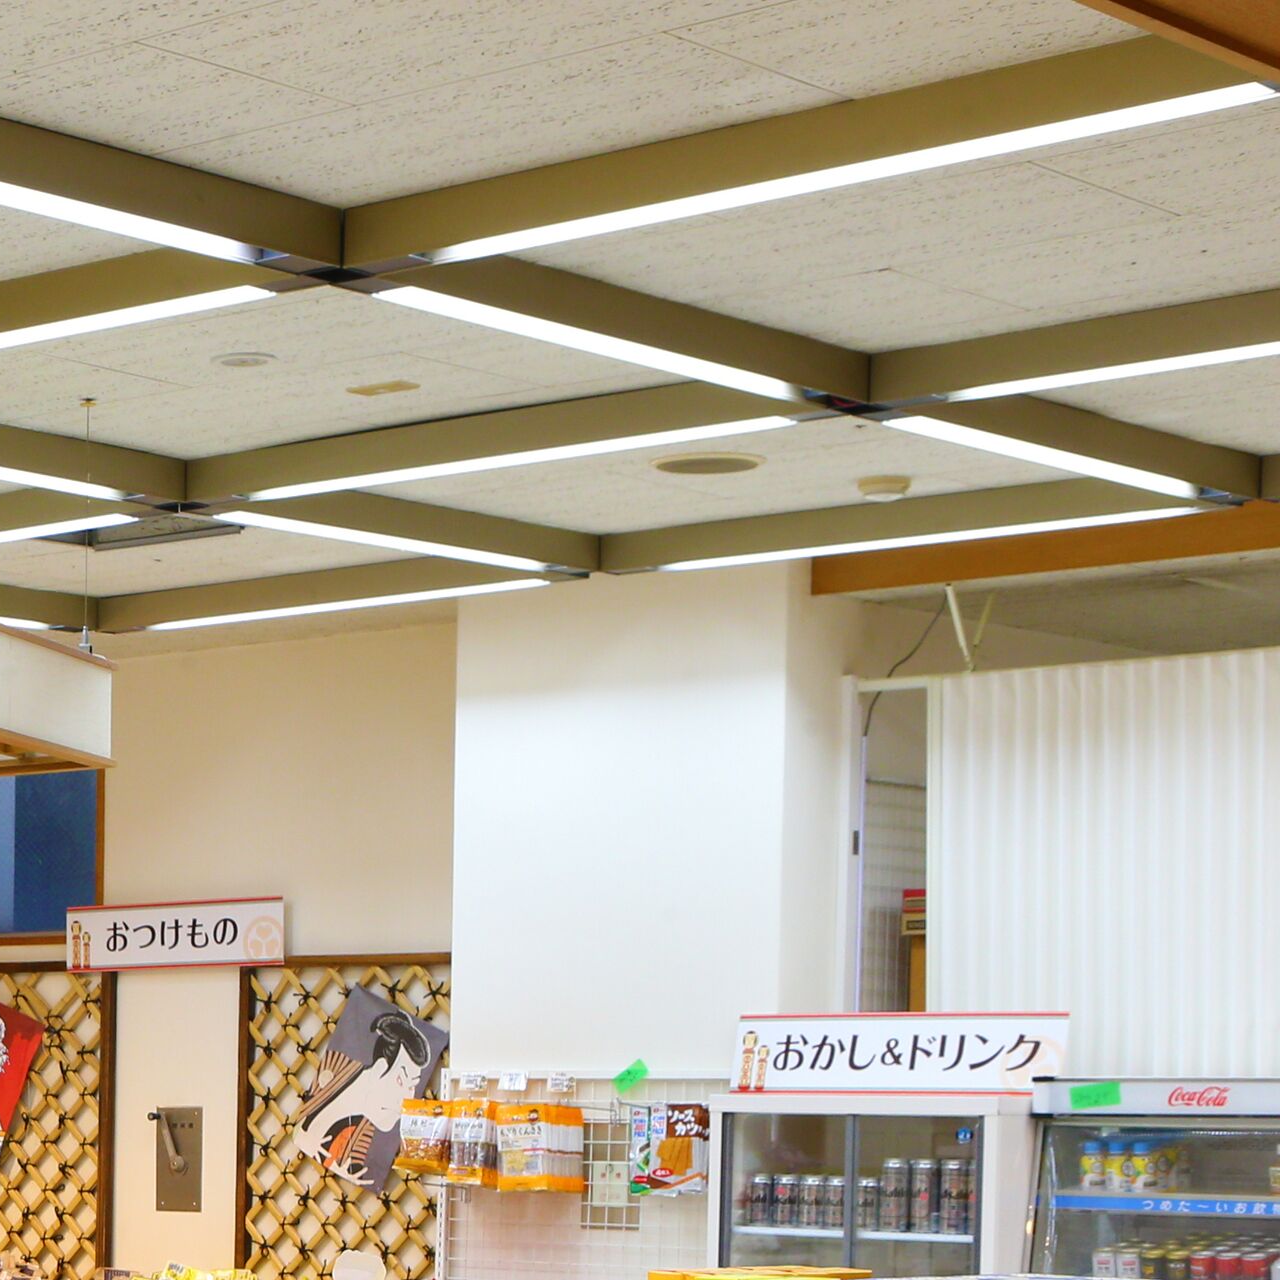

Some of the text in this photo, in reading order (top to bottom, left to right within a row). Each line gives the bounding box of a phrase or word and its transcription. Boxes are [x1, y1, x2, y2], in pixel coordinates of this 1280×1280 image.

[106, 918, 238, 952] おつけもの
[773, 1034, 1042, 1072] おかし&ドリンク
[668, 1109, 695, 1122] ソース
